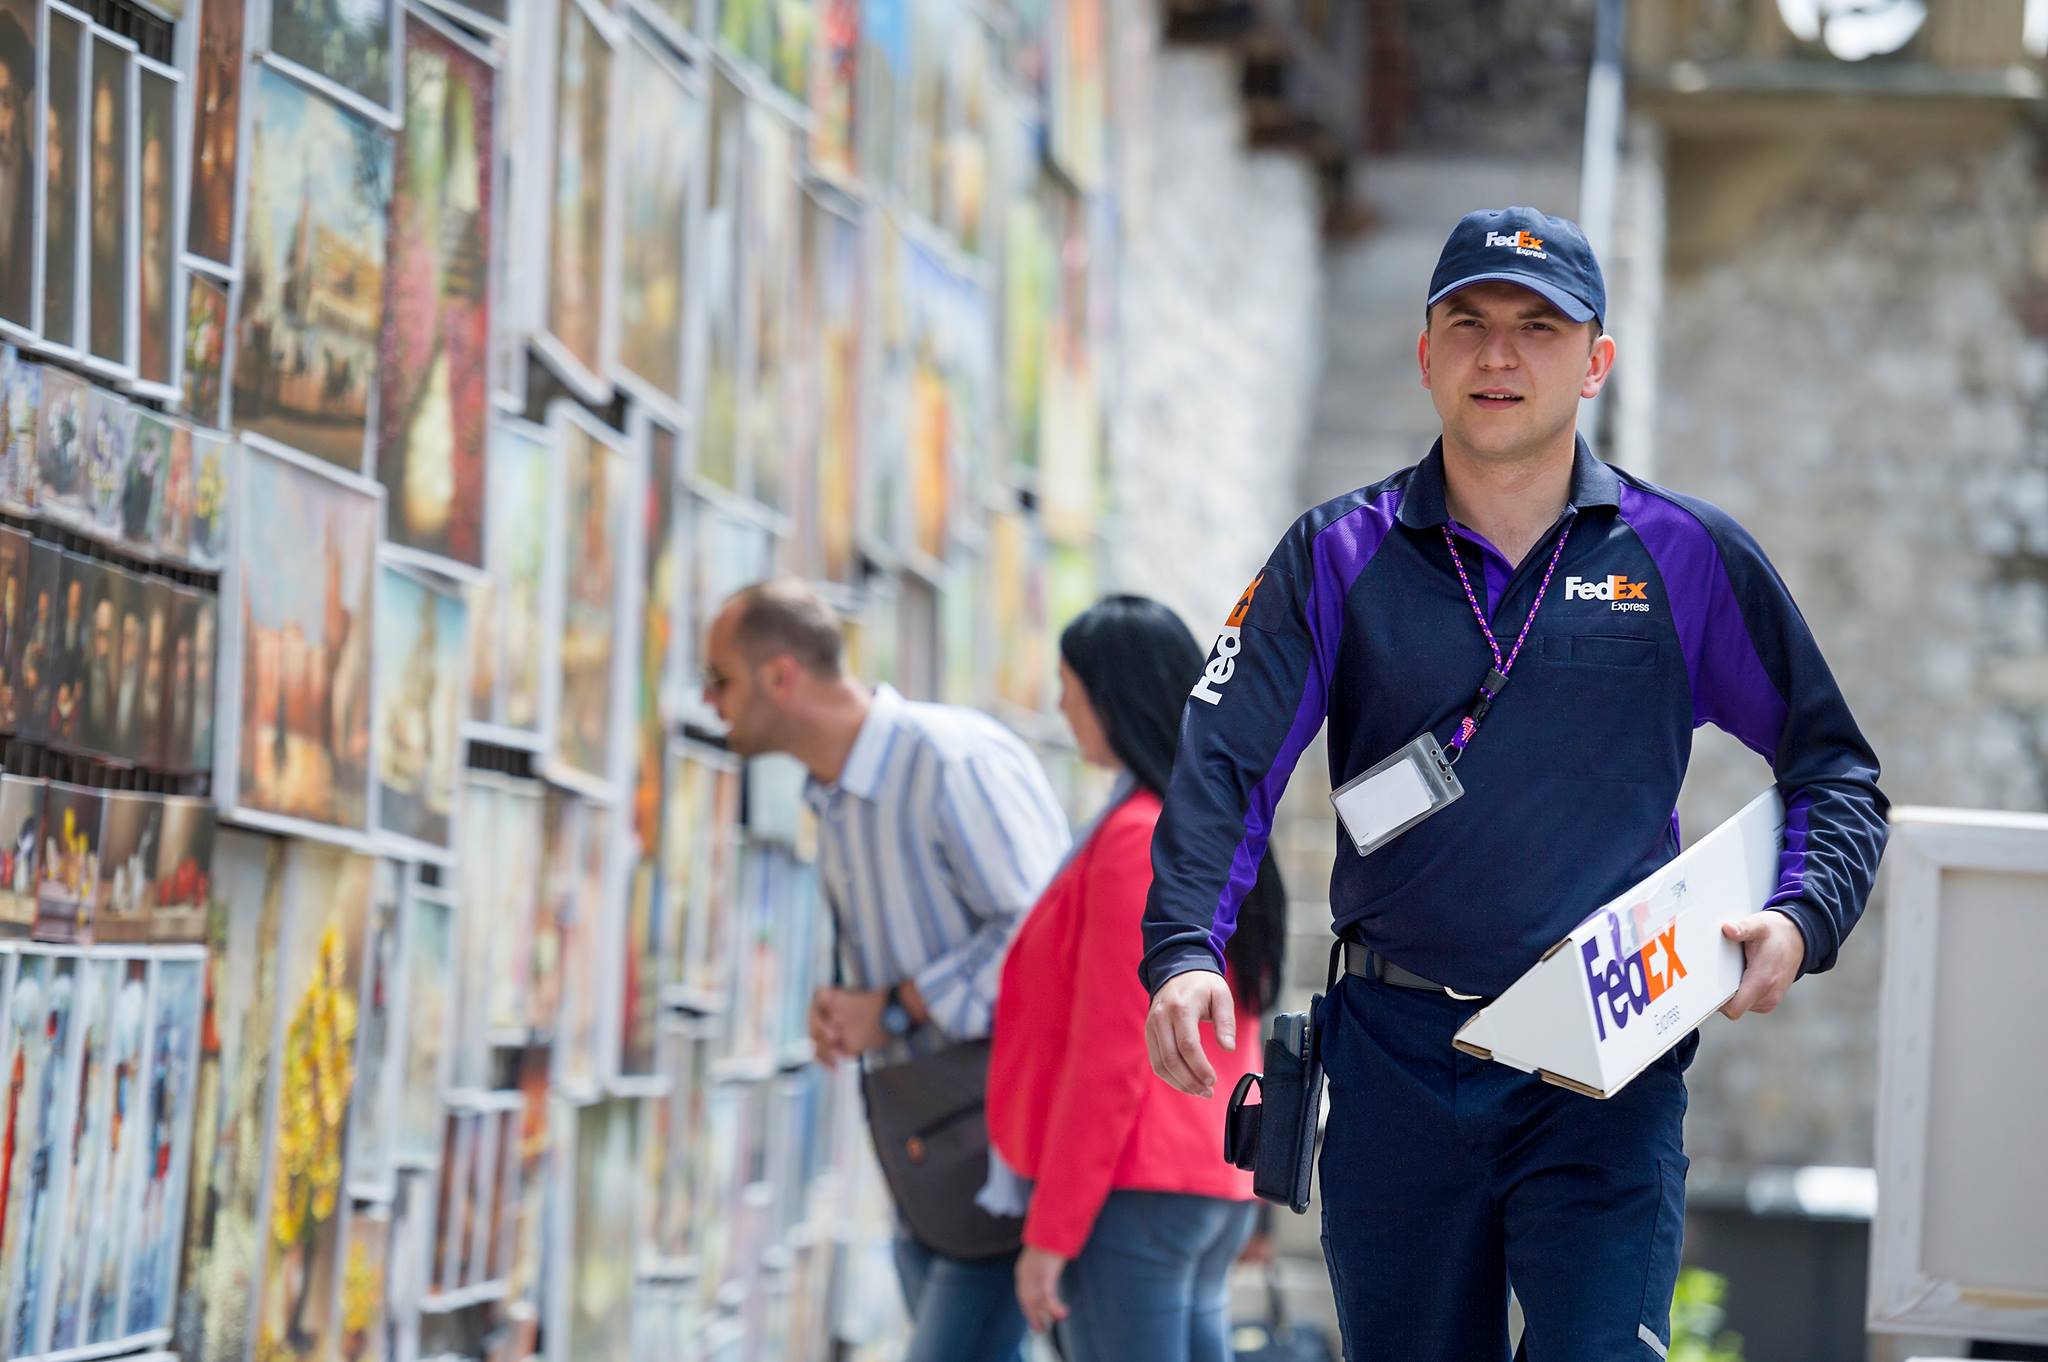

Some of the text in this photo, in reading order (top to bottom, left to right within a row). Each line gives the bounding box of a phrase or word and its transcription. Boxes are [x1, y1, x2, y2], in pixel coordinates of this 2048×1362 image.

[1485, 230, 1544, 250] FedEx
[1516, 247, 1547, 260] Express
[1565, 575, 1648, 600] FedEx
[1611, 601, 1650, 613] Express
[1581, 918, 1688, 1042] FedEx
